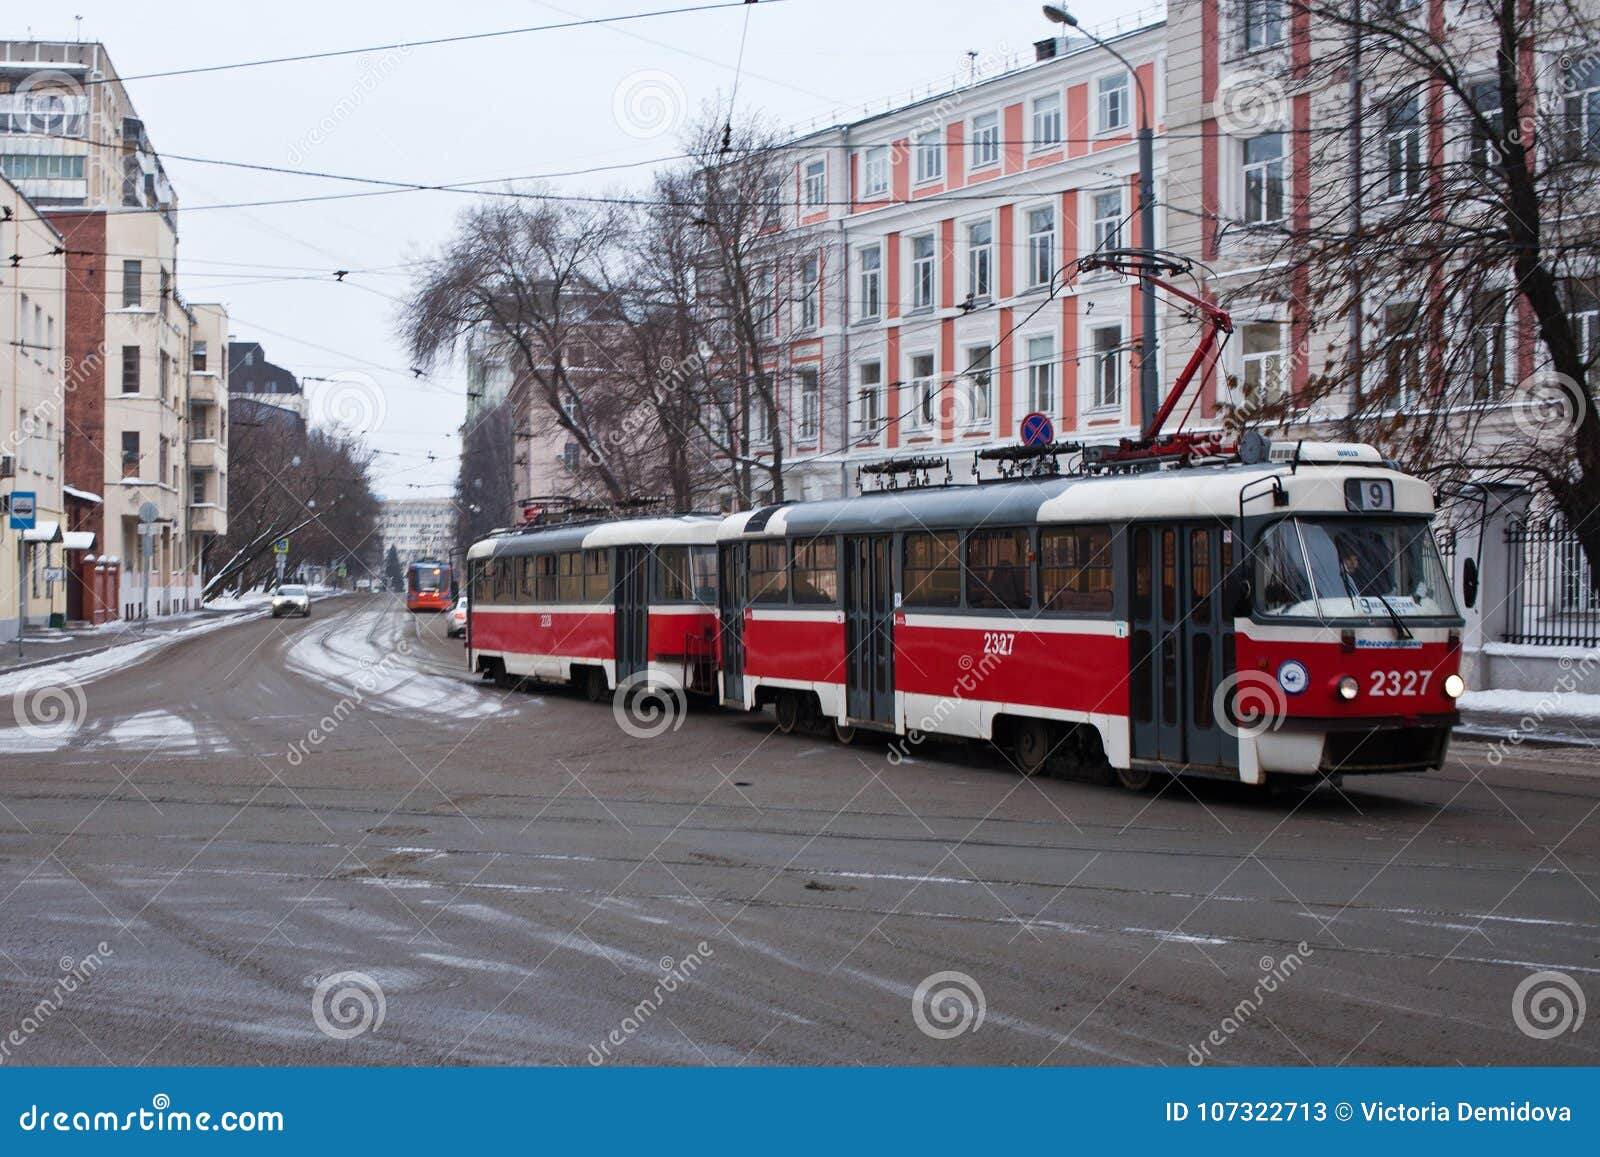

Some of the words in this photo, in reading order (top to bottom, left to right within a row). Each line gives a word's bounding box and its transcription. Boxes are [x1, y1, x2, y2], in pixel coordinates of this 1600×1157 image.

[1370, 483, 1383, 508] 9
[1361, 598, 1372, 614] 9
[983, 631, 1015, 656] 2327
[1368, 669, 1433, 697] 2327
